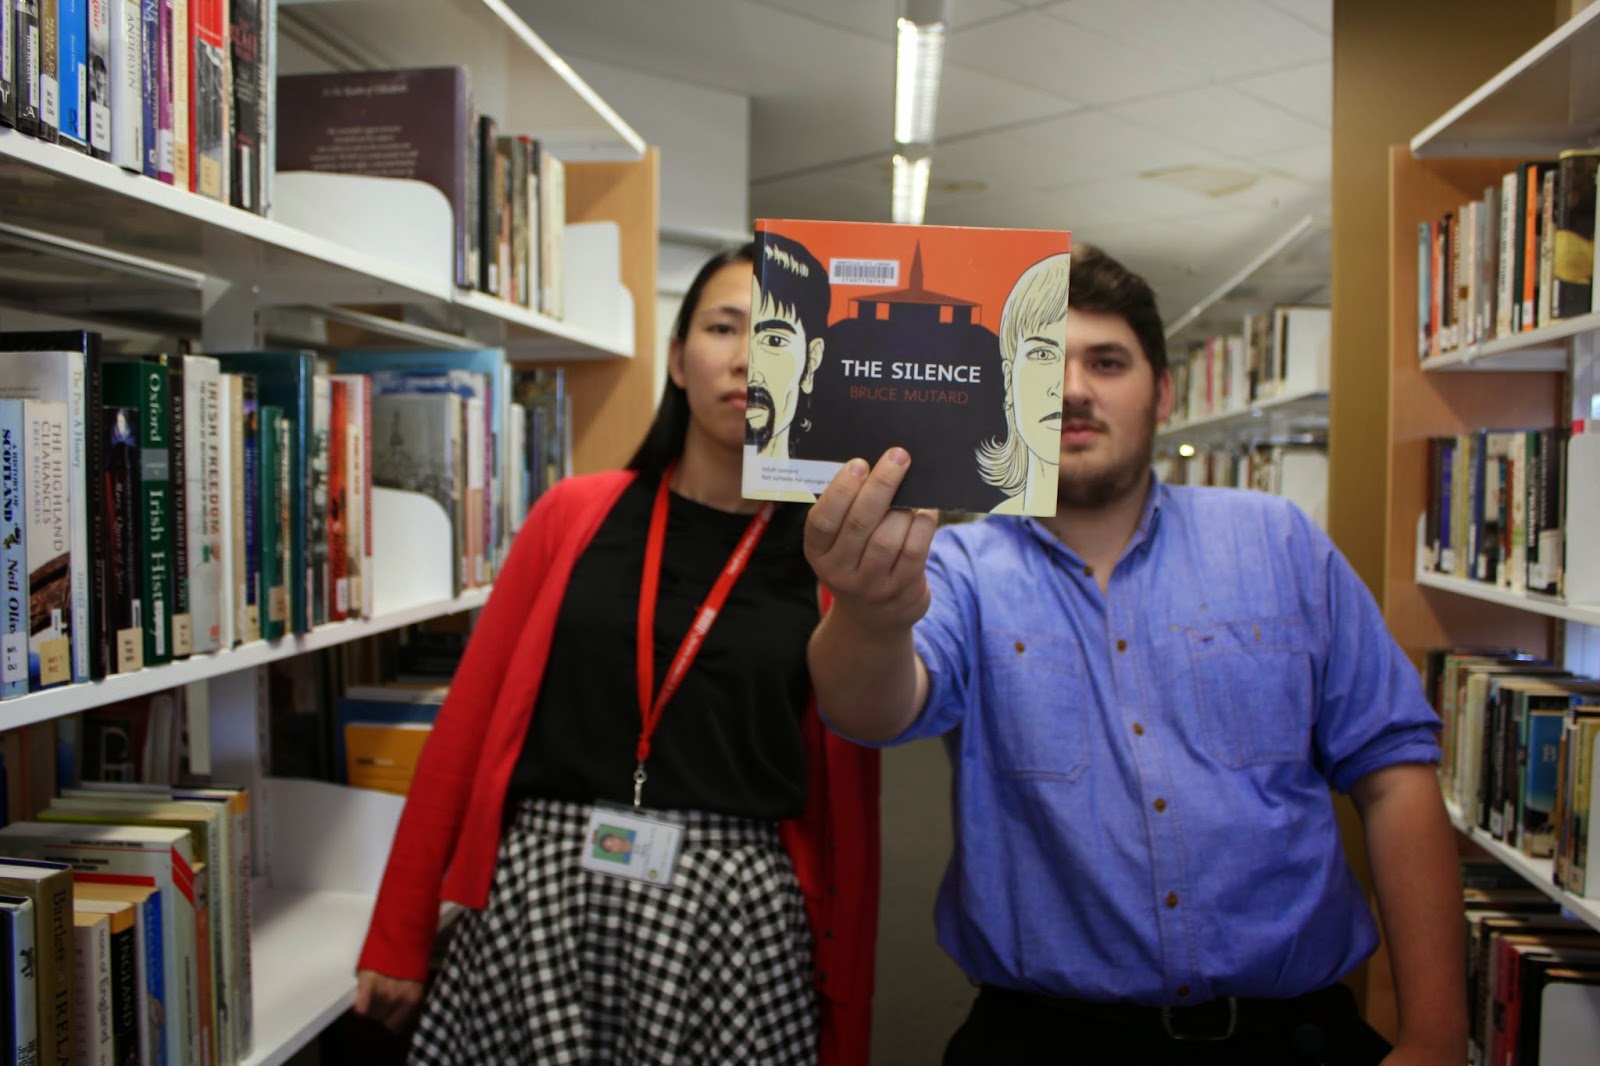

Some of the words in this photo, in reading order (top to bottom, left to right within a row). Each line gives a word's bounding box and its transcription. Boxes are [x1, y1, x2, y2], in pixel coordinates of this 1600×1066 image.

[127, 13, 137, 89] ANDERSEN
[841, 359, 882, 379] THE
[891, 362, 981, 383] SILENCE
[850, 386, 897, 401] BRUCE
[904, 389, 969, 405] MUTARD
[32, 421, 40, 450] ERIC
[52, 422, 62, 455] THE
[149, 372, 162, 442] Oxford
[208, 382, 218, 437] IRISH
[2, 428, 17, 523] SCOTLAND
[32, 455, 41, 525] RICHARDS
[41, 421, 52, 526] CLEARANCES
[52, 460, 64, 553] HIGHLAND
[208, 445, 220, 536] FREEDOM
[150, 488, 166, 541] Irish
[8, 558, 20, 593] Neil
[9, 597, 20, 635] Oliv
[53, 888, 68, 961] Bartlett
[98, 976, 111, 1044] England
[119, 934, 134, 1027] ENGLAND
